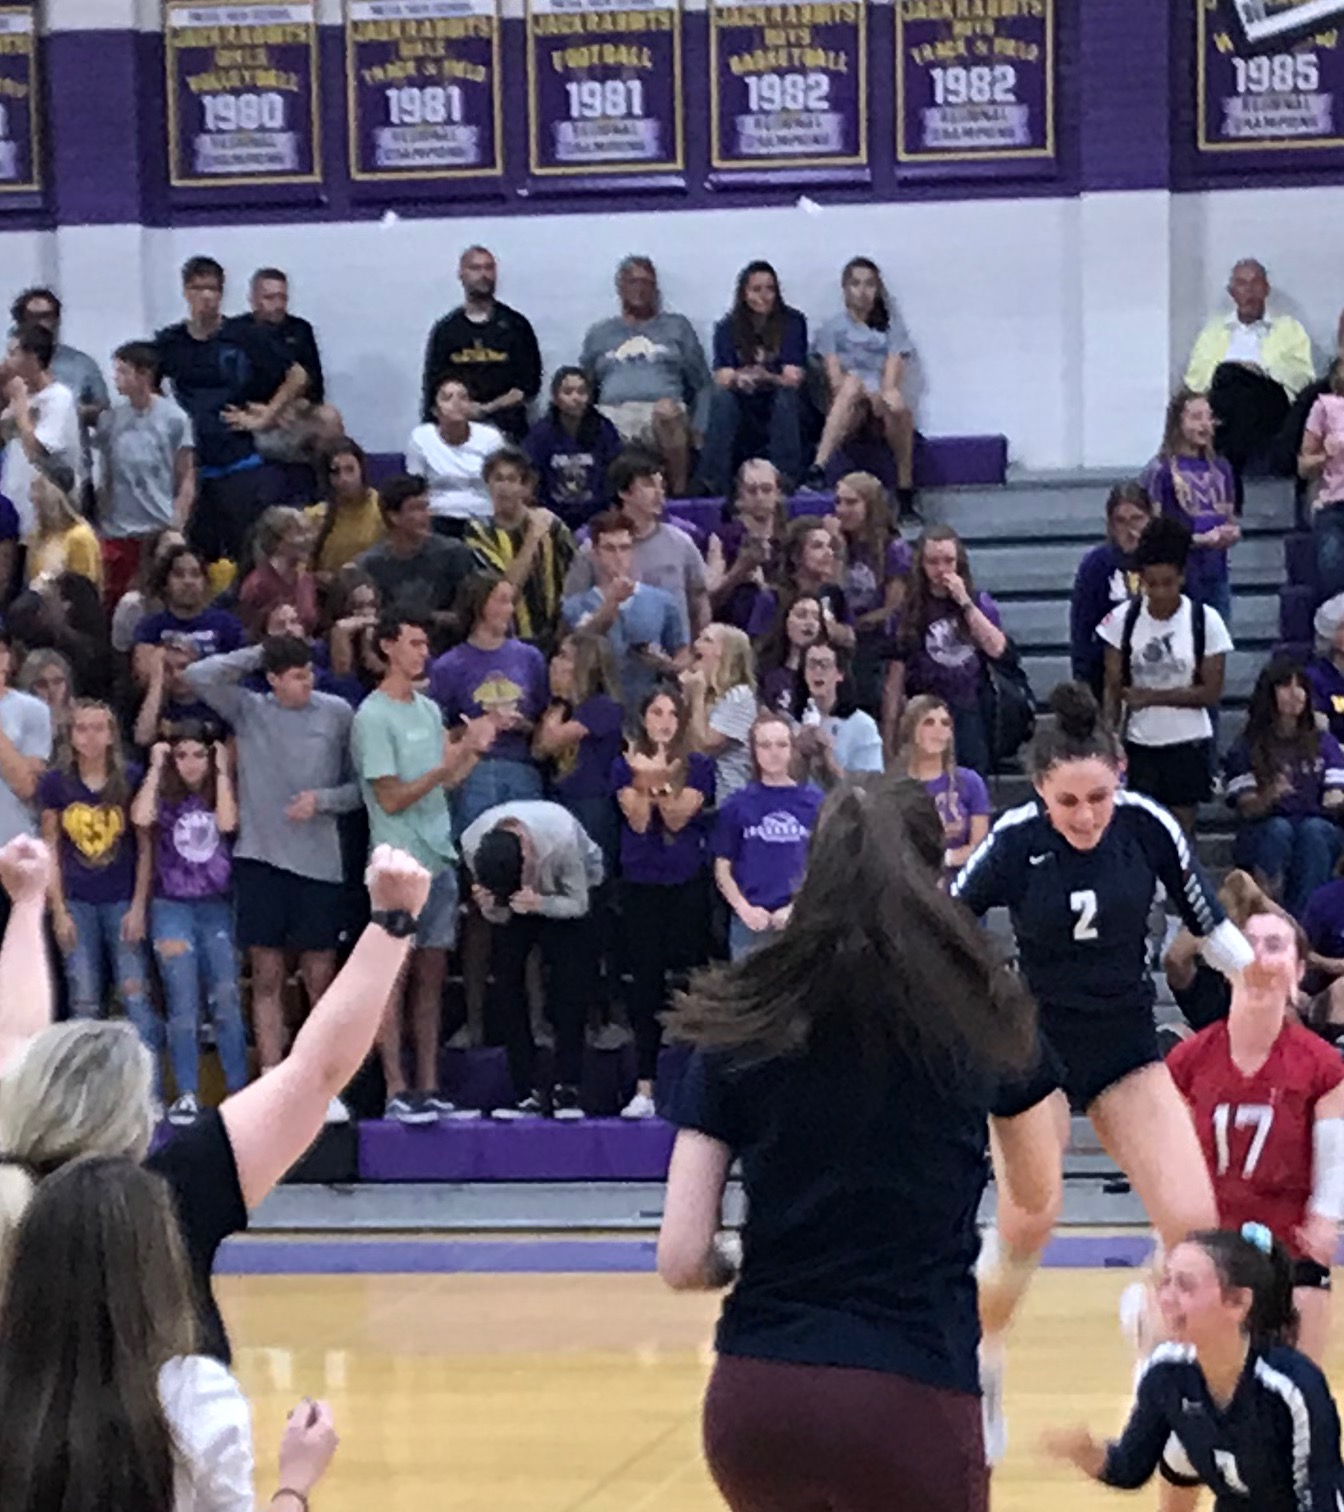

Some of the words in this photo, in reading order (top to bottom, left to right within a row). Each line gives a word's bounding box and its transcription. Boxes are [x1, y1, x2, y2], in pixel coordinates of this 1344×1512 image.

[744, 72, 830, 111] 1982
[929, 65, 1017, 104] 1982
[1231, 53, 1320, 92] 1985
[201, 92, 284, 131] 1980
[385, 85, 462, 124] 1981
[566, 79, 643, 117] 1981
[1070, 890, 1098, 940] 2
[1213, 1103, 1274, 1180] 17
